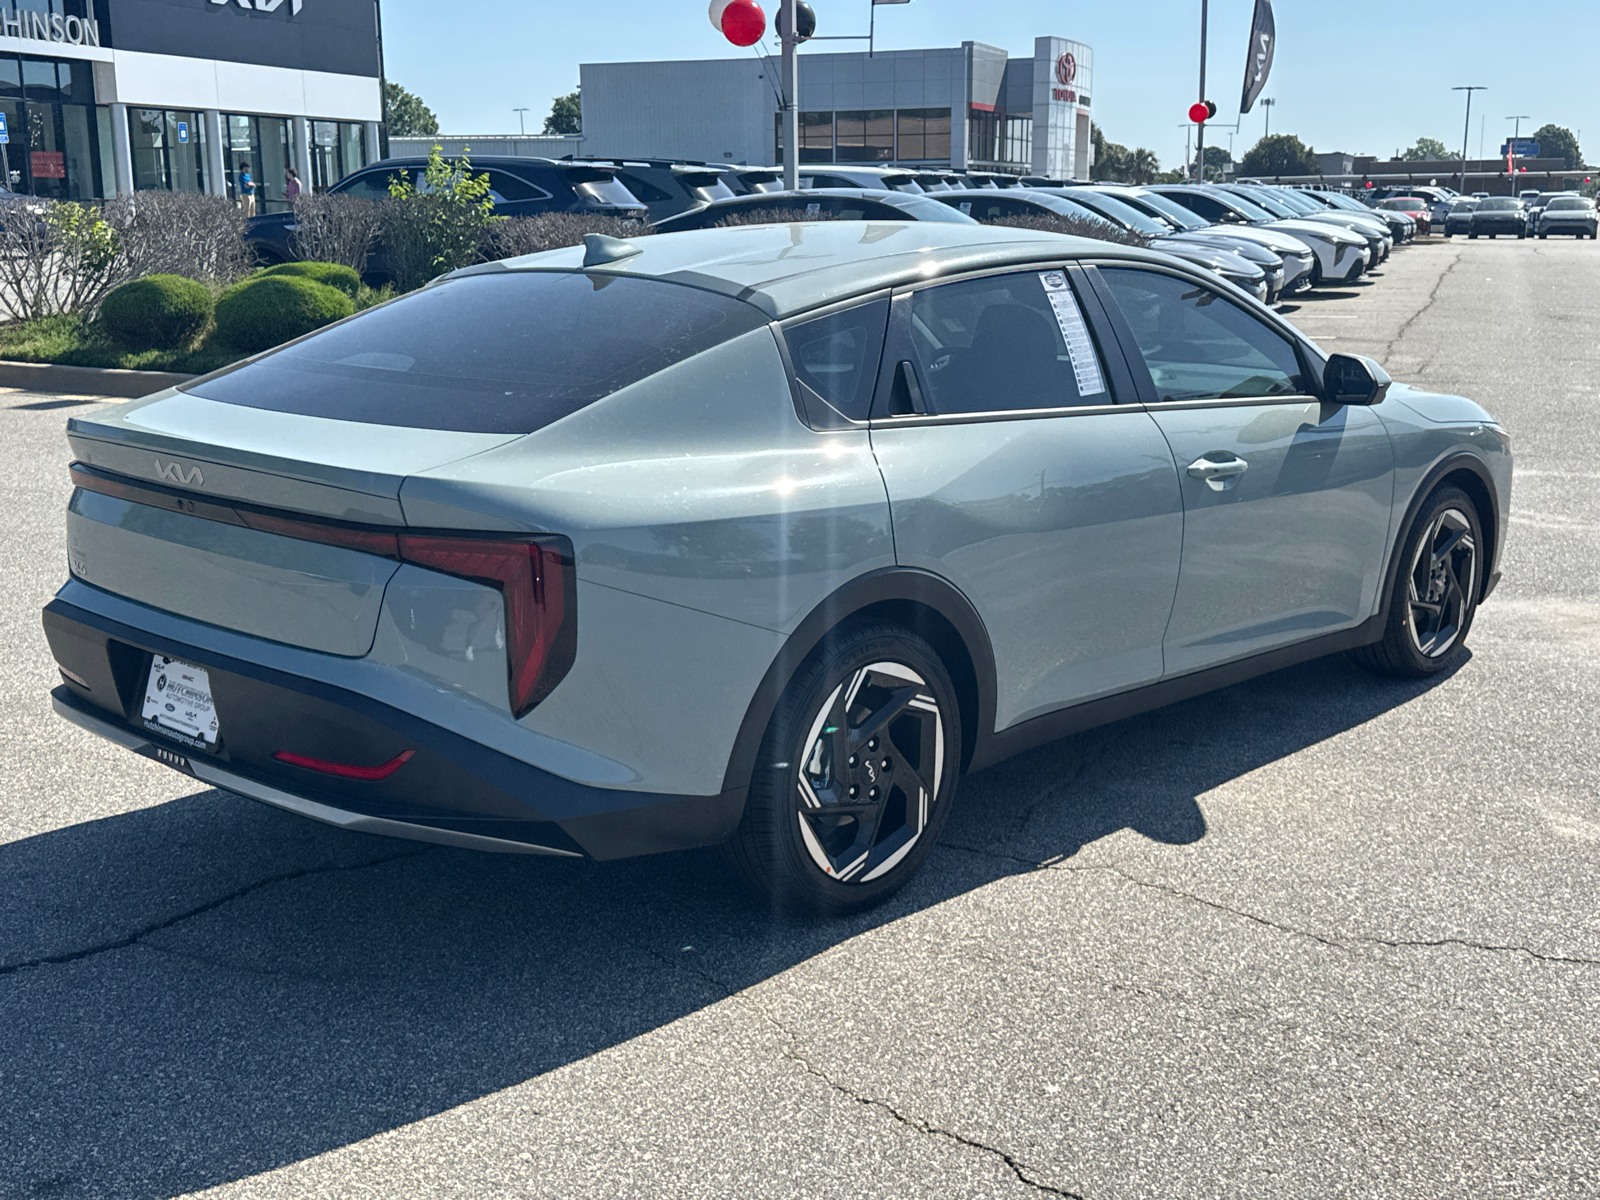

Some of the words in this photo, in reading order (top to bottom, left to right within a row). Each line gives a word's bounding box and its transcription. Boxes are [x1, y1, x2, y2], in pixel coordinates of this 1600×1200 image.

[1052, 88, 1077, 102] TOYOTA
[154, 458, 205, 487] KIA
[166, 683, 214, 705] HUTCHINSON
[166, 693, 193, 709] AUTOMOTIVE
[194, 702, 211, 712] GROUP
[185, 711, 197, 719] KIA
[865, 759, 876, 783] KIA
